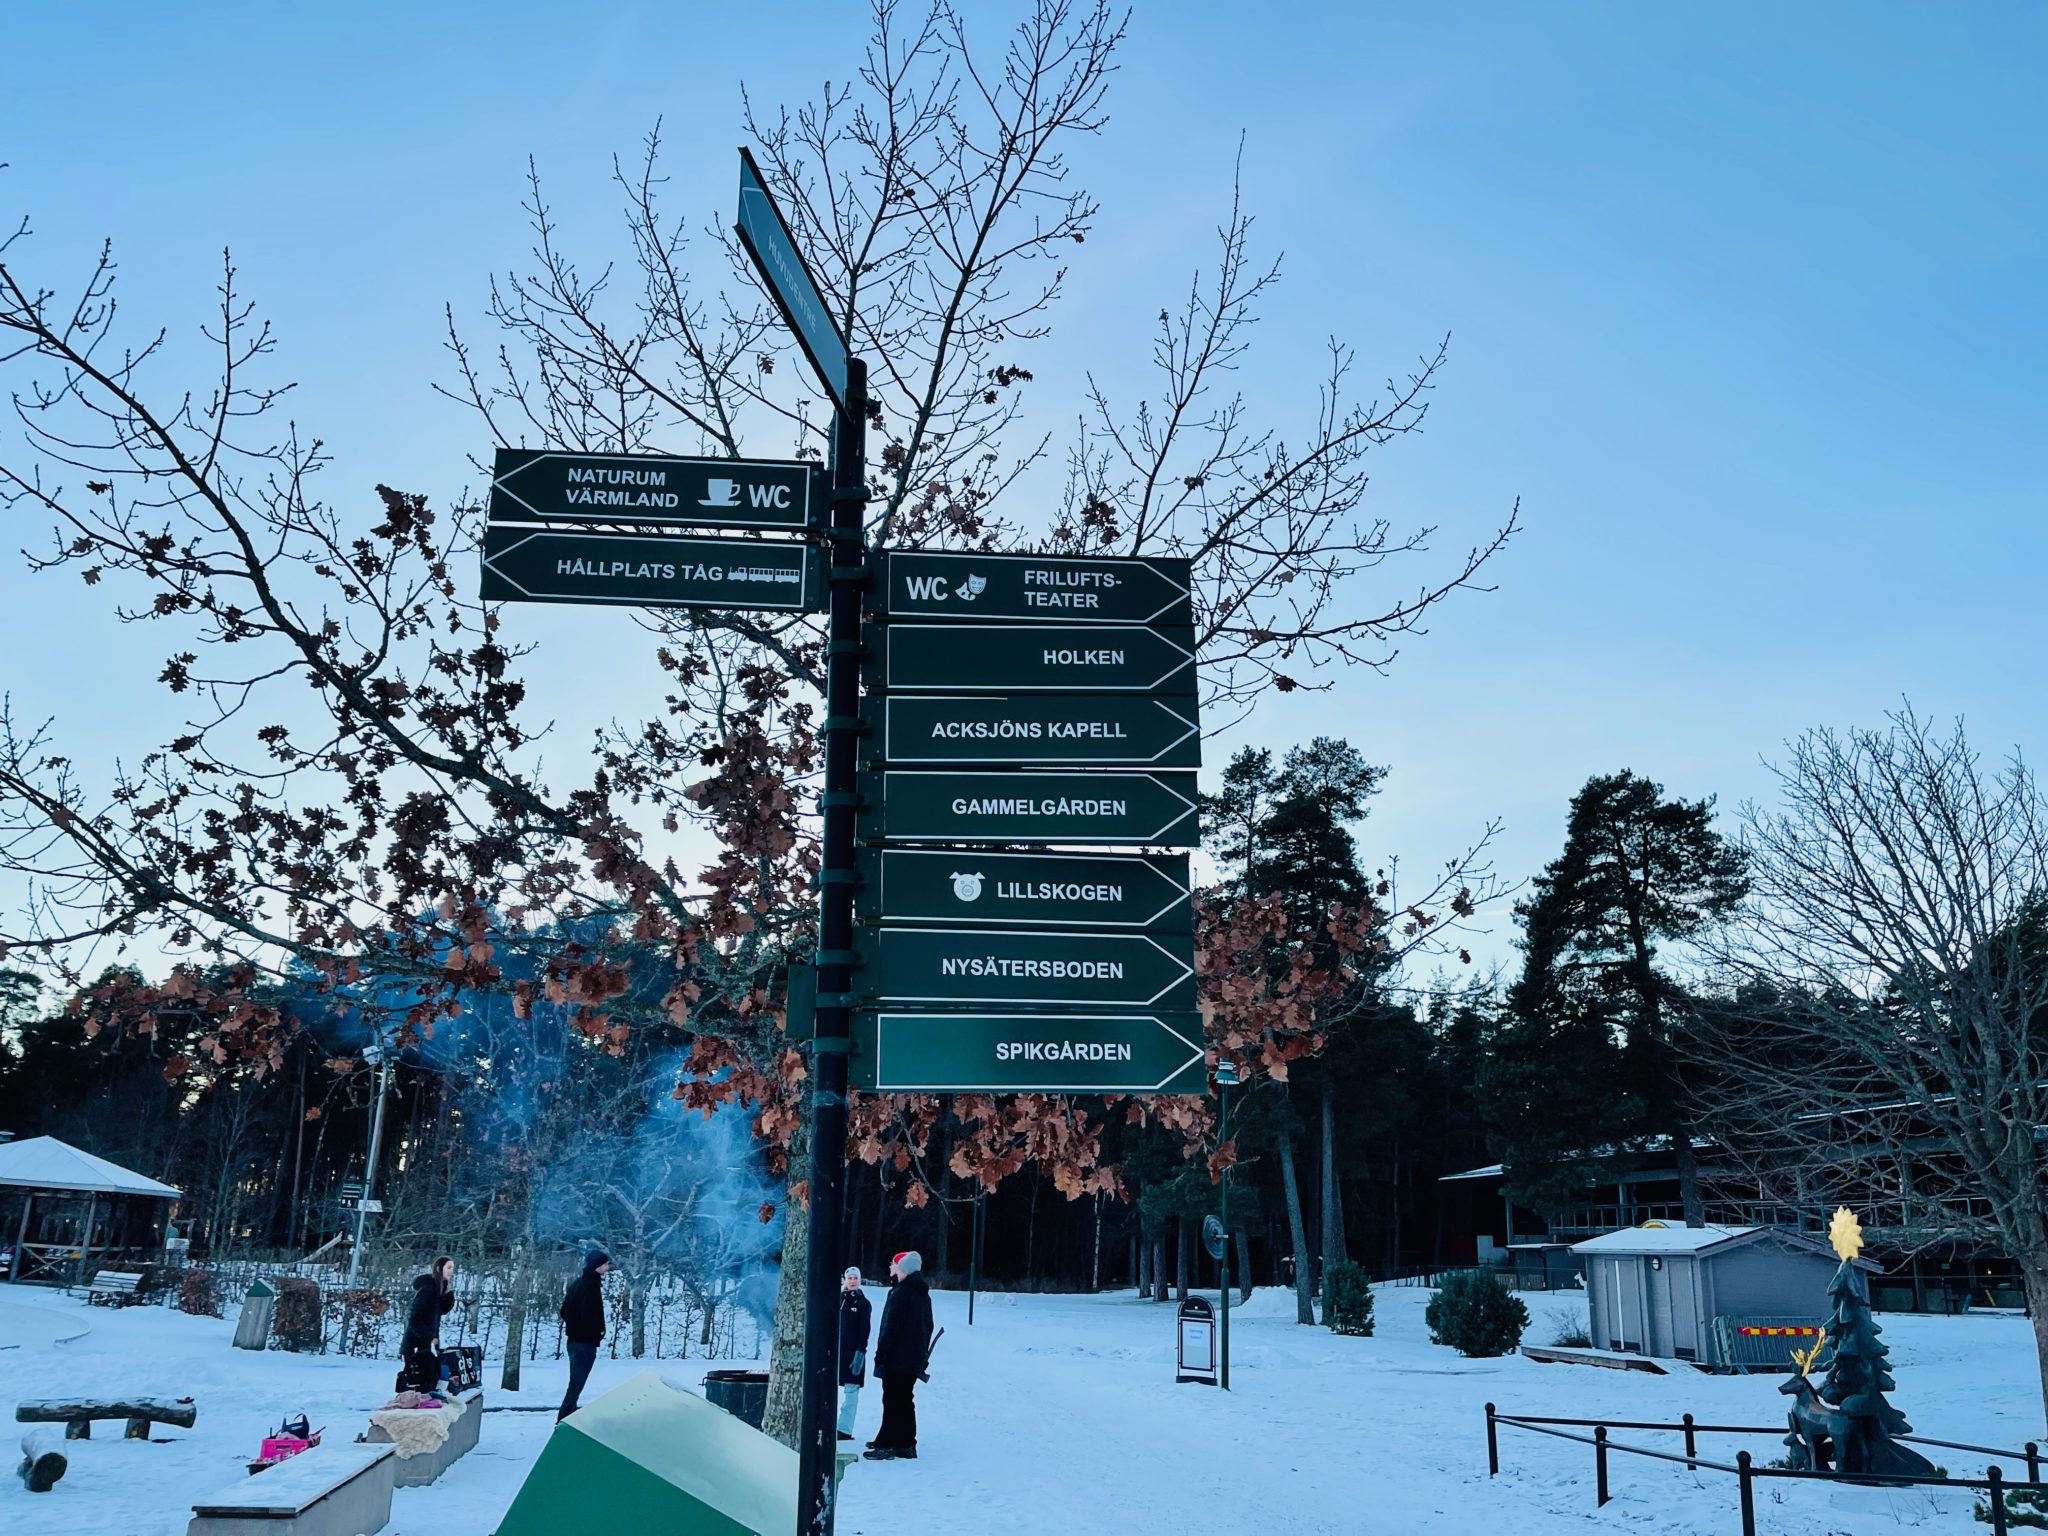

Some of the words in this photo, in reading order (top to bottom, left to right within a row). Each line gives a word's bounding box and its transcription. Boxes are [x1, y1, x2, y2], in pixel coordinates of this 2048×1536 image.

[568, 468, 666, 486] NATURUM
[565, 487, 679, 508] VÄRMLAND
[748, 484, 791, 509] WC
[557, 557, 675, 579] HÅLLPLATS
[682, 563, 723, 581] TÅG
[1024, 570, 1122, 588] FRILUFTS-
[905, 576, 949, 601] WC
[1023, 591, 1099, 608] TEATER
[1043, 649, 1125, 665] HOLKEN
[931, 719, 1042, 738] ACKSJÖNS
[1047, 722, 1127, 738] KAPELL
[951, 796, 1126, 816] GAMMELGÅRDEN
[997, 881, 1122, 902] LILLSKOGEN
[942, 956, 1123, 979] NYSÄTERSBODEN
[996, 1040, 1131, 1061] SPIKGÅRDEN
